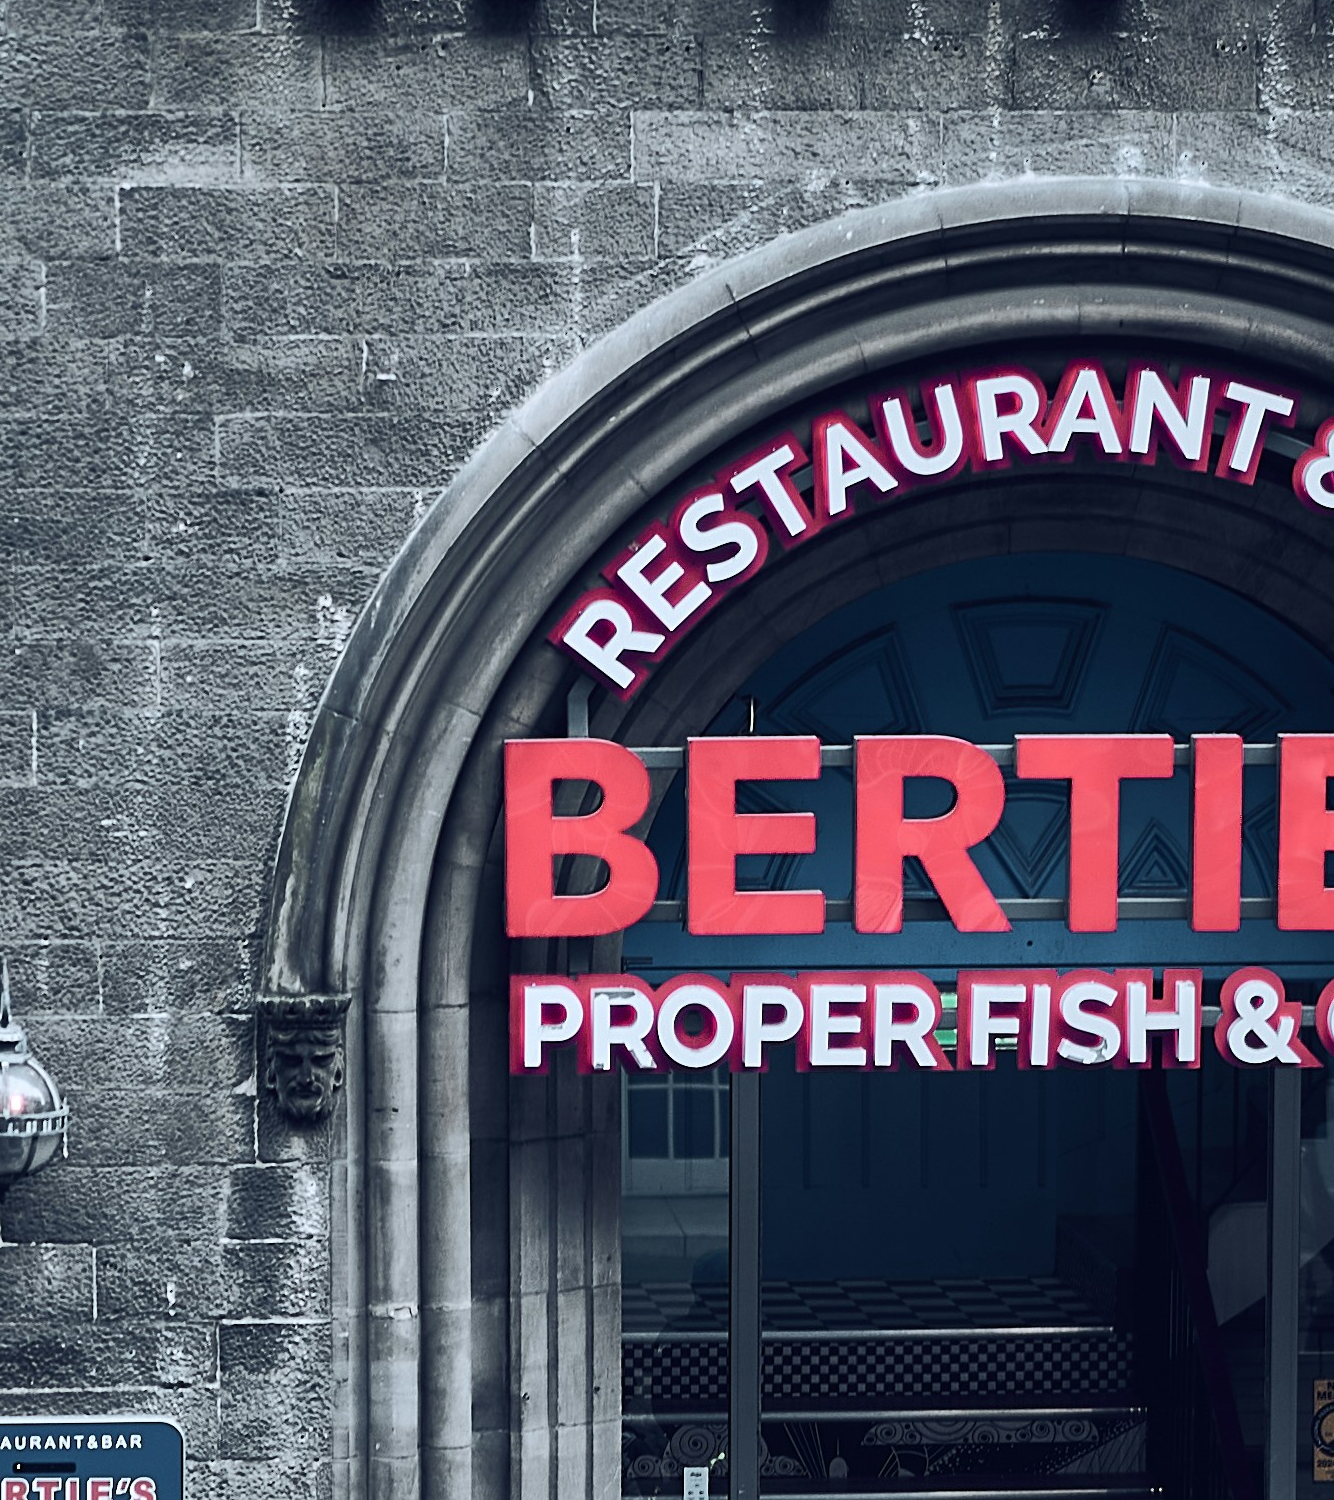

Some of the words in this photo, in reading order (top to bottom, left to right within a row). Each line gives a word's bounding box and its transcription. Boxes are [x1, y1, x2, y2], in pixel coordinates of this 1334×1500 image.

[552, 363, 1297, 698] RESTAURANT
[512, 976, 945, 1073] PROPER
[967, 974, 1203, 1072] FISH
[1220, 970, 1317, 1068] &
